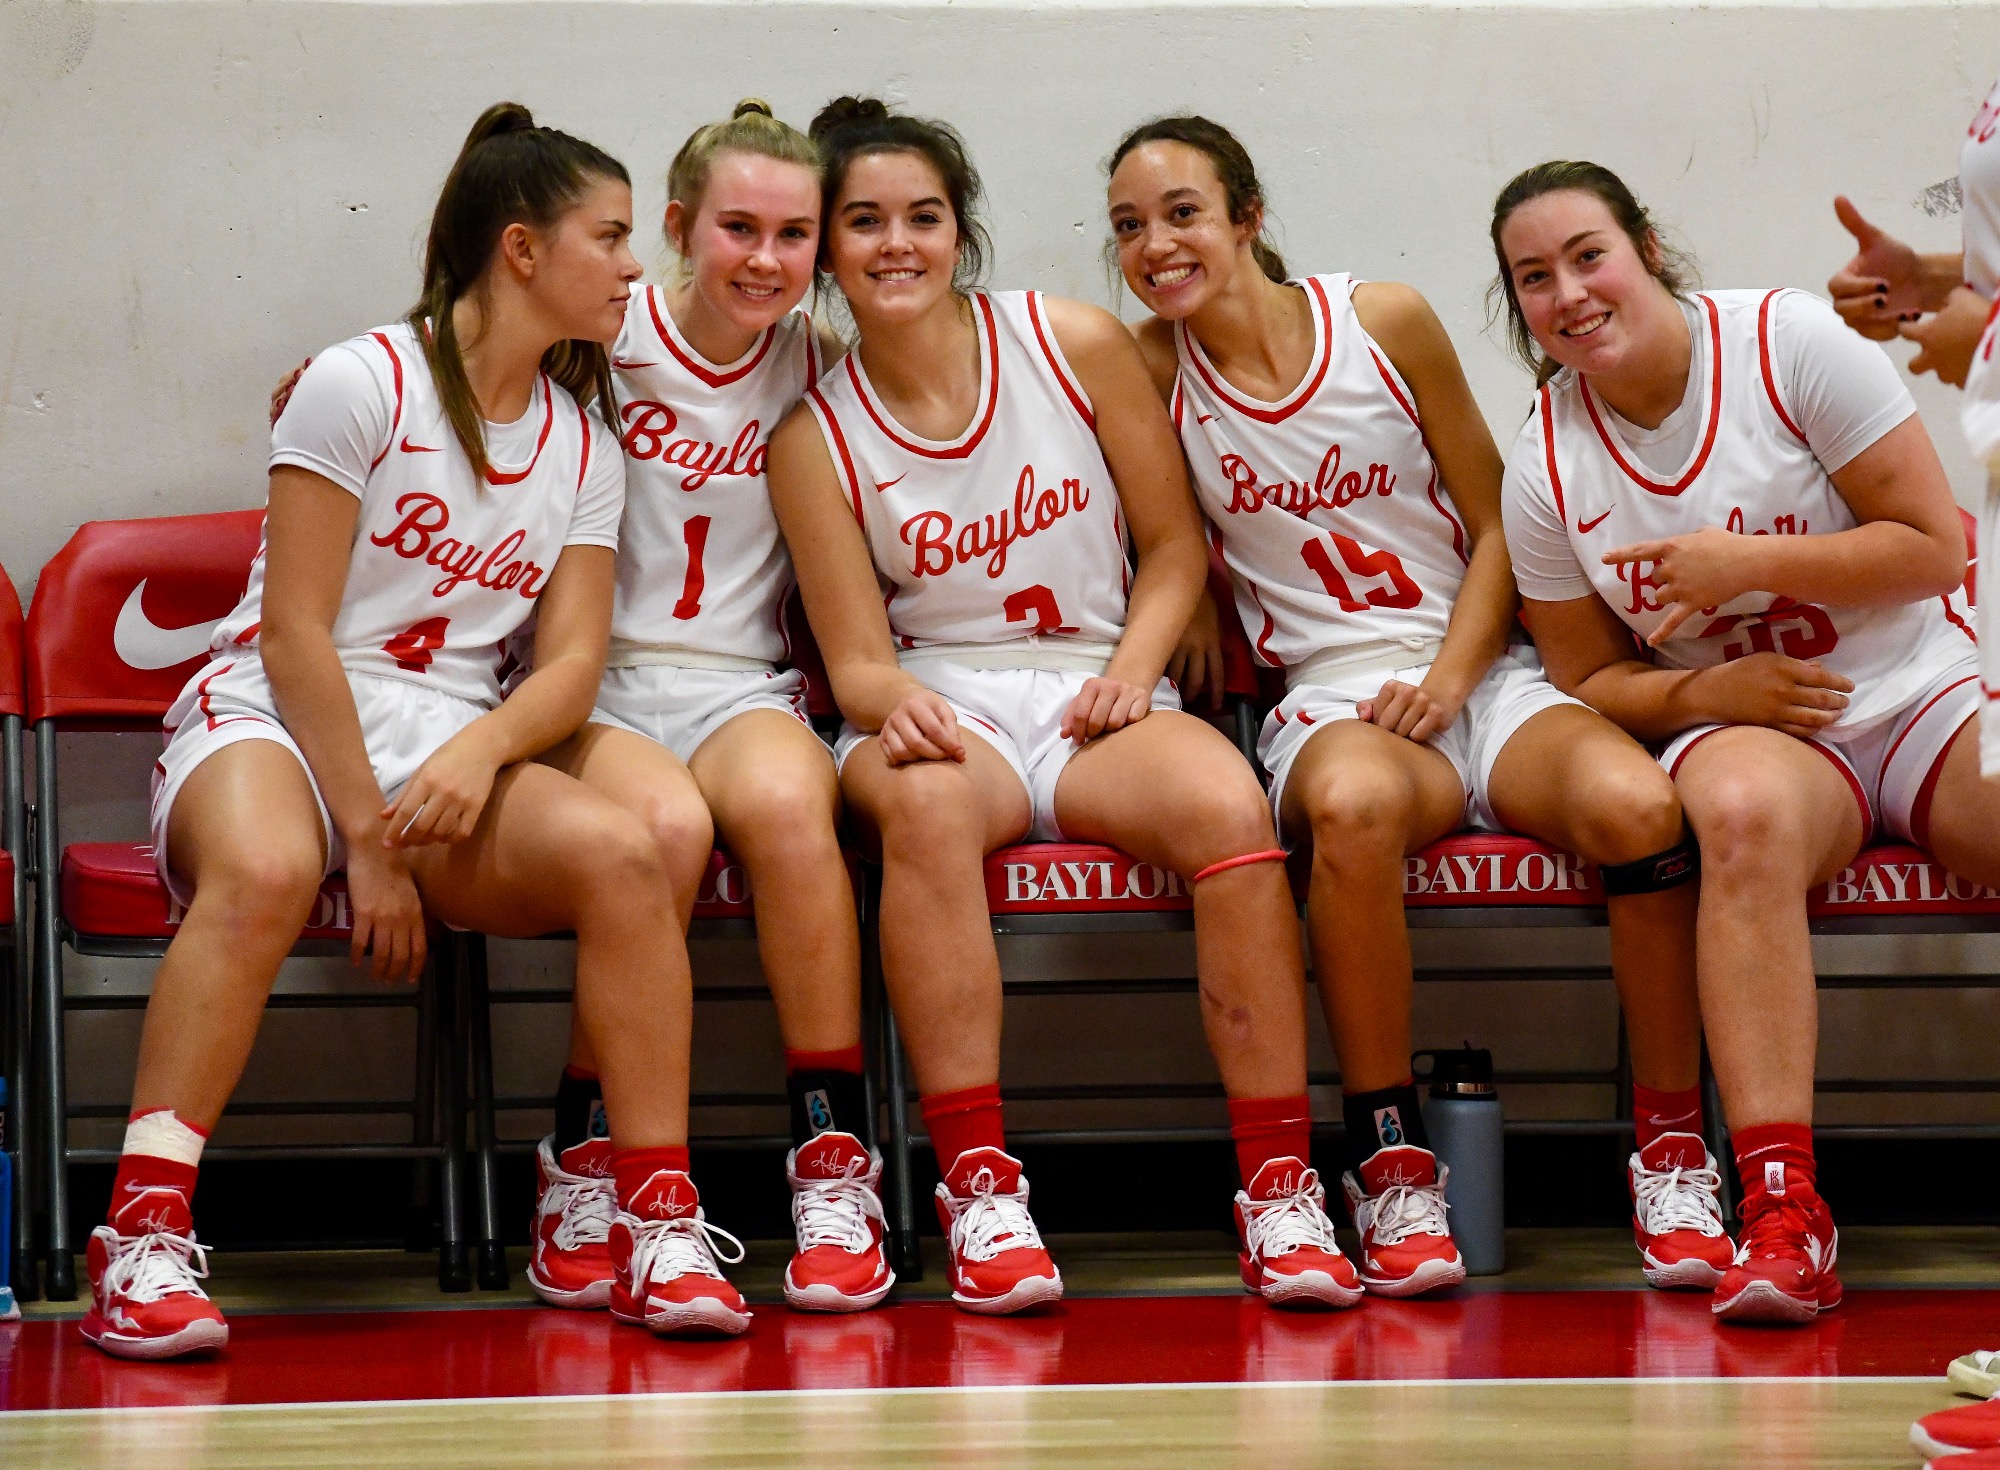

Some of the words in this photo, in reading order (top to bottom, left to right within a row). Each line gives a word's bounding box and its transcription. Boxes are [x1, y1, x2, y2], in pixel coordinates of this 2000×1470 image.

[621, 400, 767, 492] Baylo
[1221, 443, 1397, 520] Baylor
[370, 492, 544, 599] Baylor
[899, 464, 1090, 579] Baylor
[672, 515, 712, 620] 1
[381, 616, 451, 674] 4
[1403, 853, 1589, 894] BAYLOR
[1825, 863, 2000, 904] BAYLO
